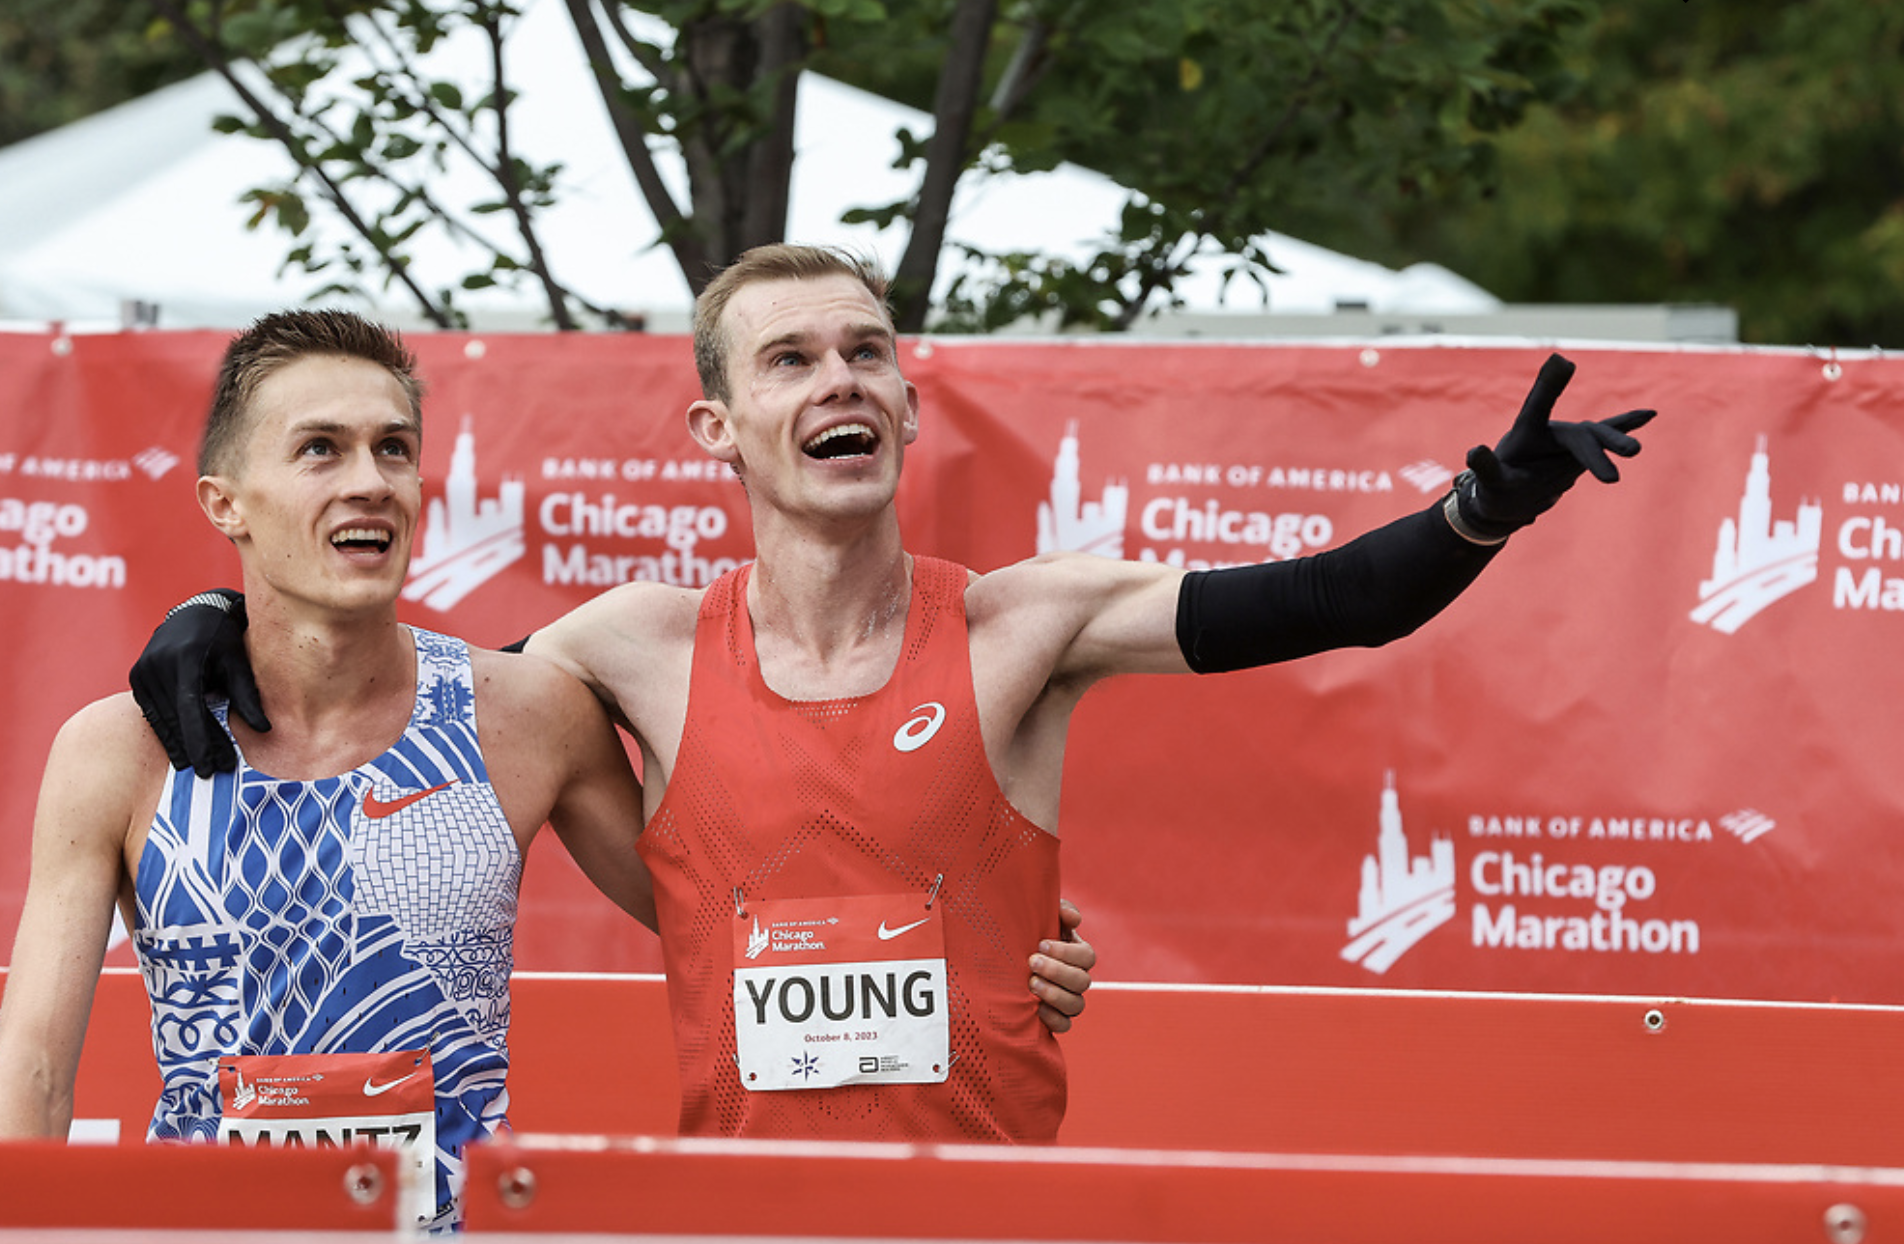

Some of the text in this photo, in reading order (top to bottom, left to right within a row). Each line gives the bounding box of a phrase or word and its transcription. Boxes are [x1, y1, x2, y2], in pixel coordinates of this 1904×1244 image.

[541, 458, 616, 479] BANK
[621, 459, 657, 481] OF
[1147, 463, 1394, 492] BANK OF AMERICA
[539, 491, 728, 550] Chicago
[1141, 496, 1333, 558] Chicago
[1468, 814, 1713, 842] BANK OF AMERICA
[1470, 850, 1657, 911] Chicago
[772, 930, 814, 943] Chicago
[1471, 903, 1700, 954] Marathon
[772, 940, 826, 952] Marathon
[745, 970, 935, 1025] YOUNG
[804, 1033, 841, 1043] October
[854, 1031, 878, 1041] 2023
[258, 1085, 298, 1098] Chicago
